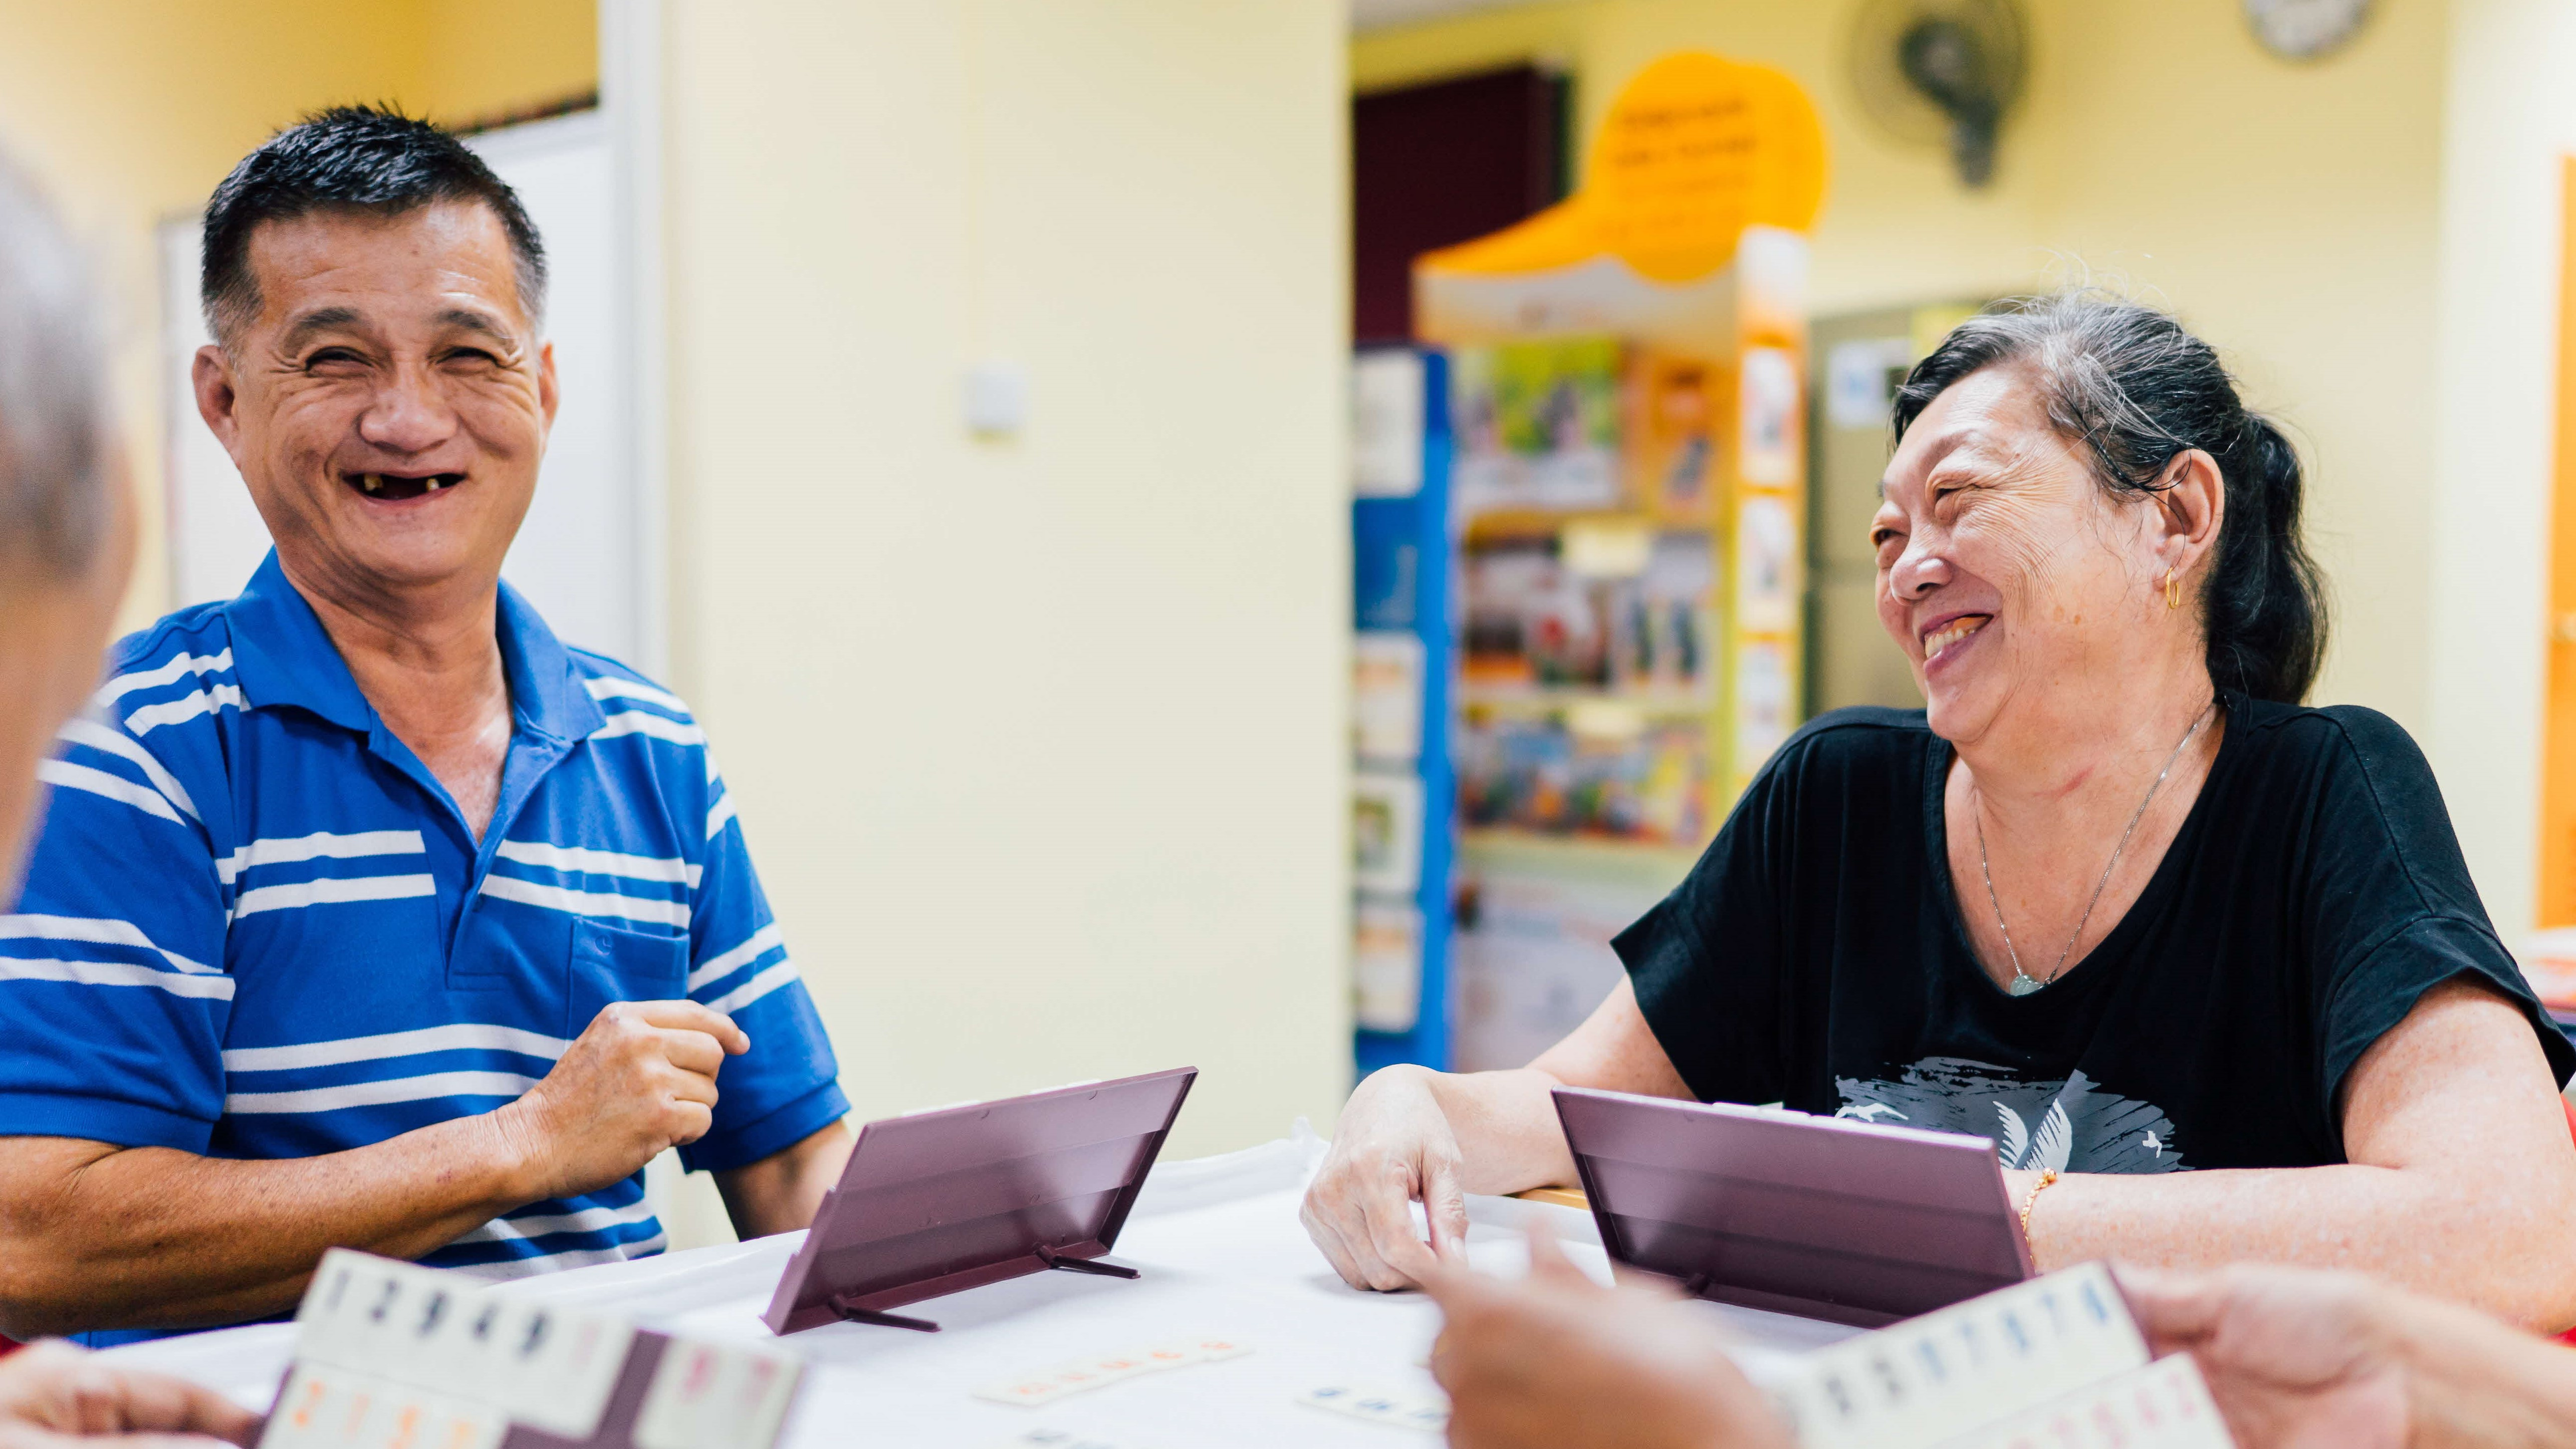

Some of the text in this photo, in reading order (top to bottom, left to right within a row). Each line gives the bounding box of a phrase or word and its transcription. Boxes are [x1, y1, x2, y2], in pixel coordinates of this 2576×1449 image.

[370, 1277, 402, 1323] 2
[417, 1291, 449, 1337] 9
[517, 1311, 550, 1358] 9
